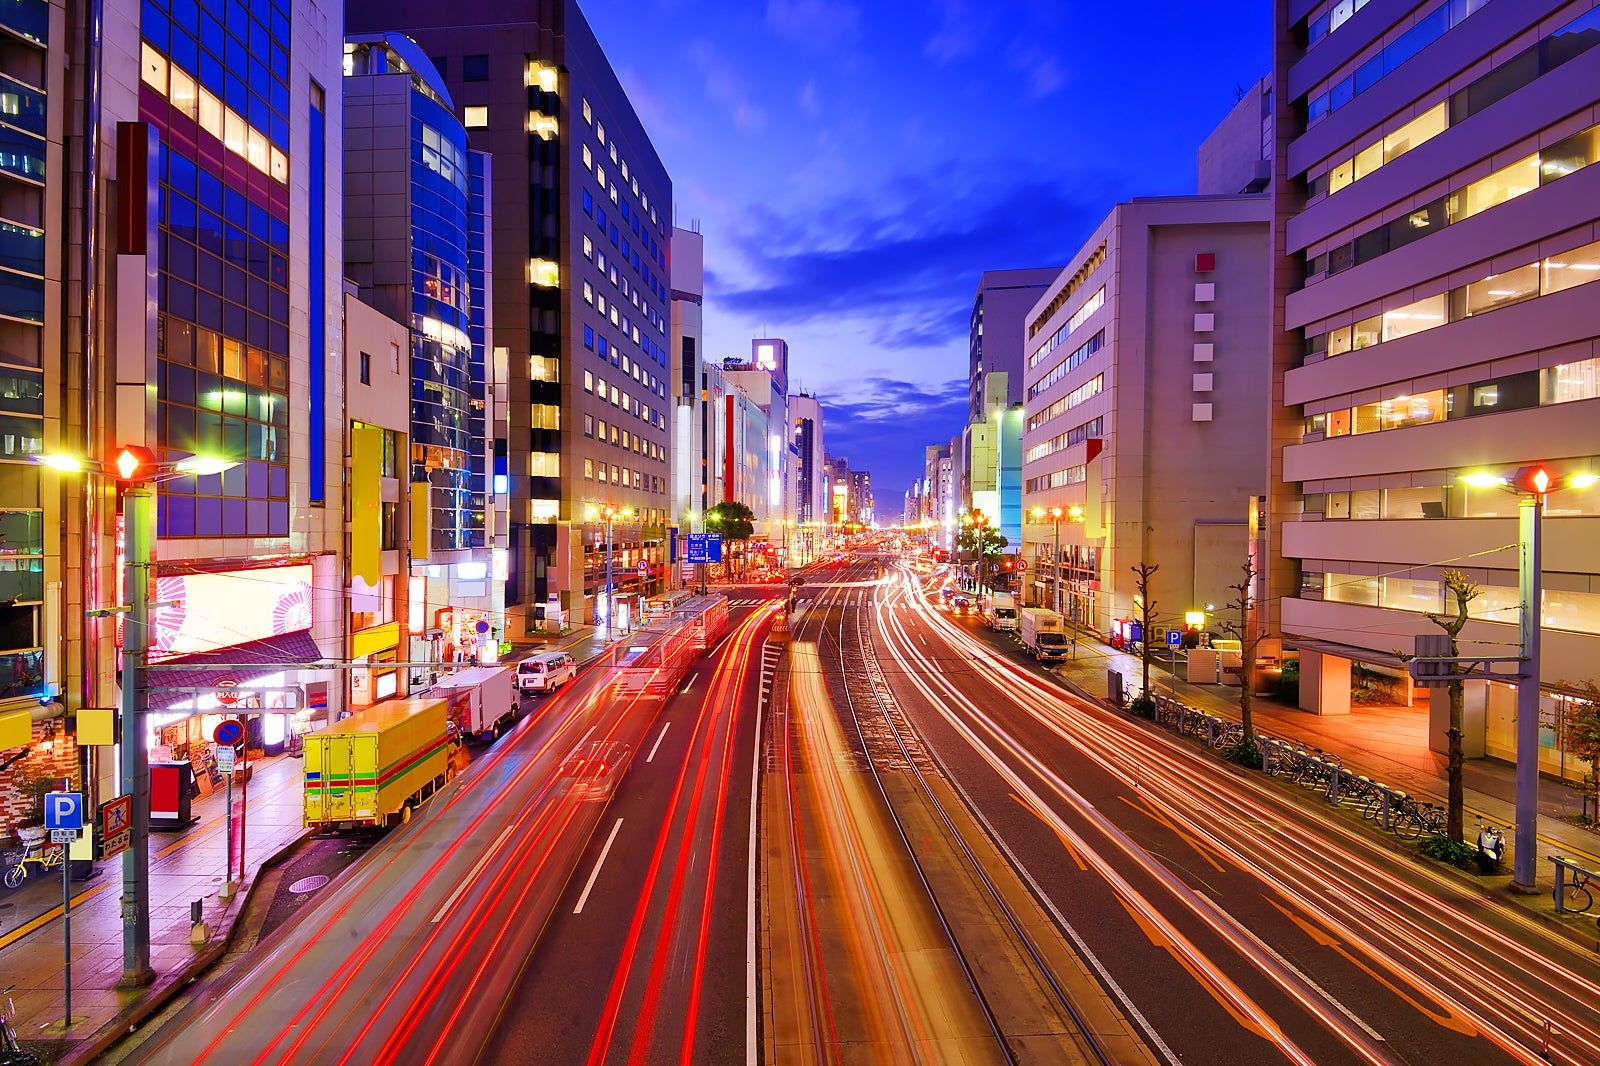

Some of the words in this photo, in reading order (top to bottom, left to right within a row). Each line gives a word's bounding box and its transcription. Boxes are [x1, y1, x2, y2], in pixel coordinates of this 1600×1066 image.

[1171, 633, 1179, 643] P
[55, 797, 75, 825] P
[105, 835, 129, 850] わたるな
